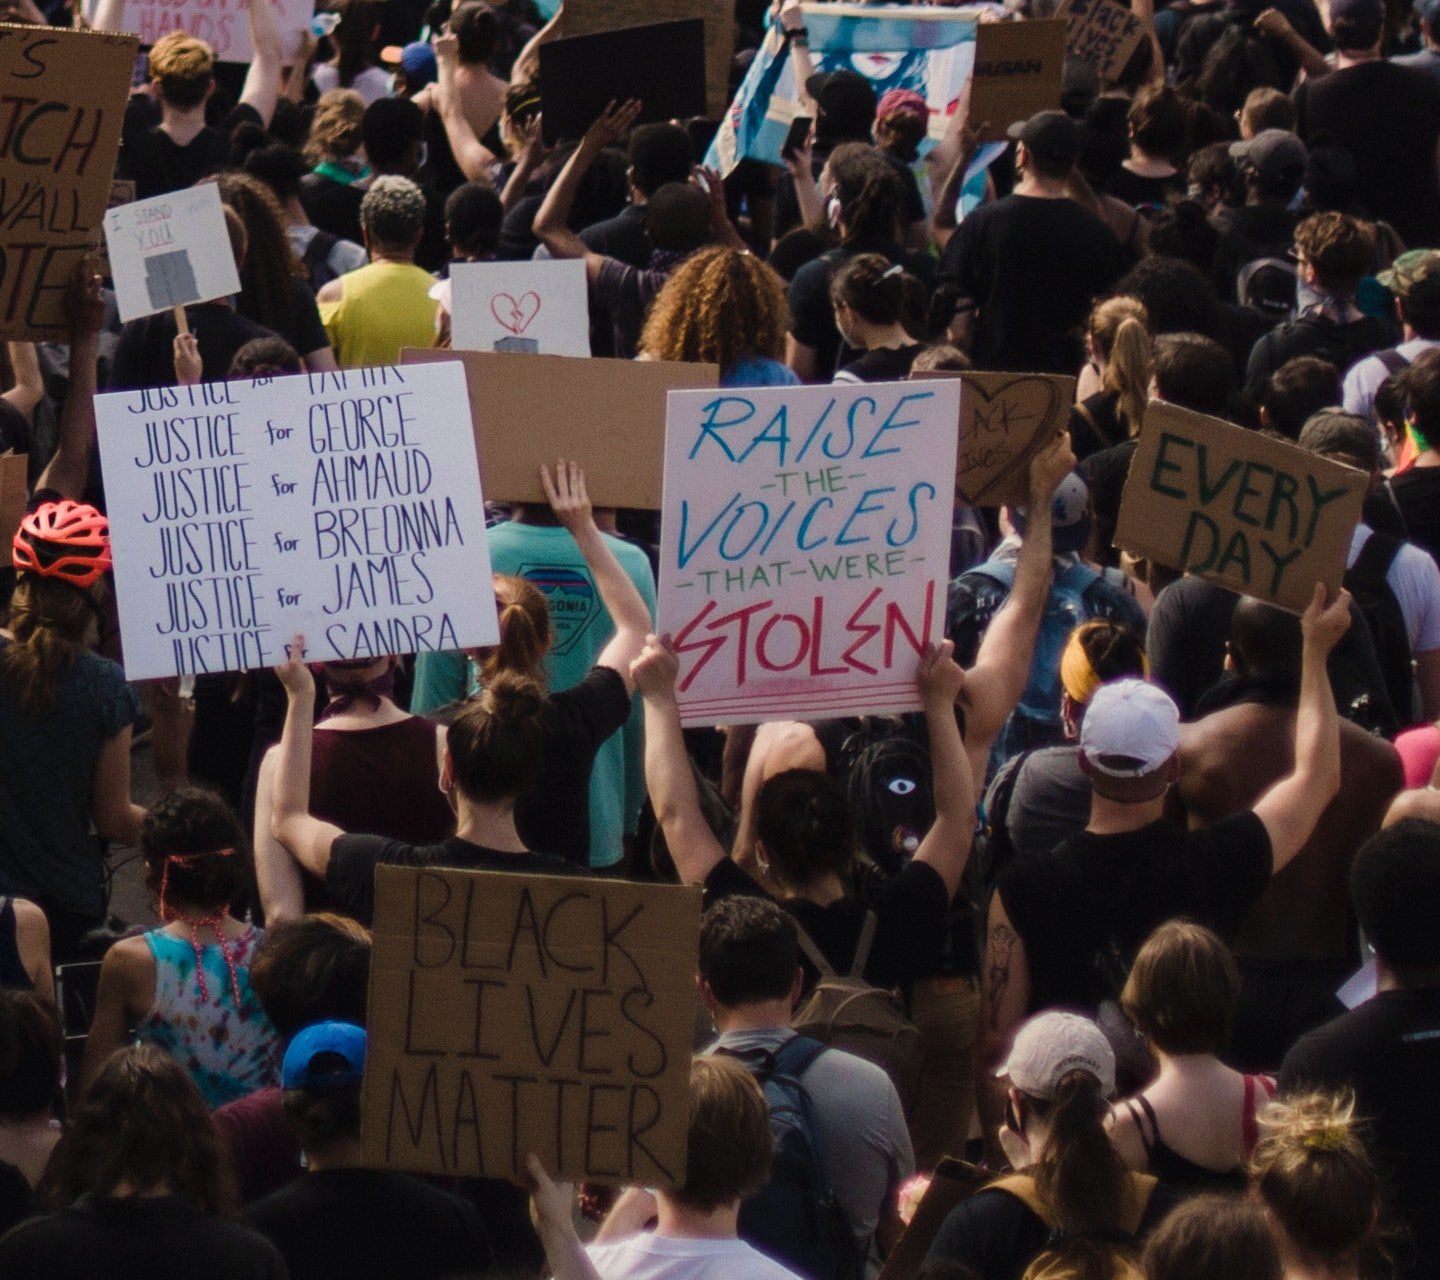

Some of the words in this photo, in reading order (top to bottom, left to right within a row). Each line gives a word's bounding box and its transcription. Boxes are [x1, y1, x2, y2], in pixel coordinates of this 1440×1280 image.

[135, 413, 245, 468] JUSTICE
[264, 419, 294, 446] for
[308, 392, 421, 454] GEORGE
[688, 391, 935, 467] RAISE
[143, 463, 252, 523] JUSTICE
[271, 474, 298, 496] for
[312, 449, 432, 507] AHMAUD
[677, 481, 936, 569] VOICES
[1150, 432, 1349, 548] EVERY
[149, 518, 260, 578] JUSTICE
[274, 532, 299, 553] for
[314, 496, 464, 560] BREONNA
[1178, 511, 1302, 596] DAY
[156, 574, 271, 635] JUSTICE
[277, 587, 304, 608] for
[322, 551, 435, 615] JAMES
[671, 579, 935, 693] STOLEN
[415, 872, 649, 990] BLACK
[405, 971, 668, 1078] LIVES
[386, 1062, 675, 1181] MATTER
